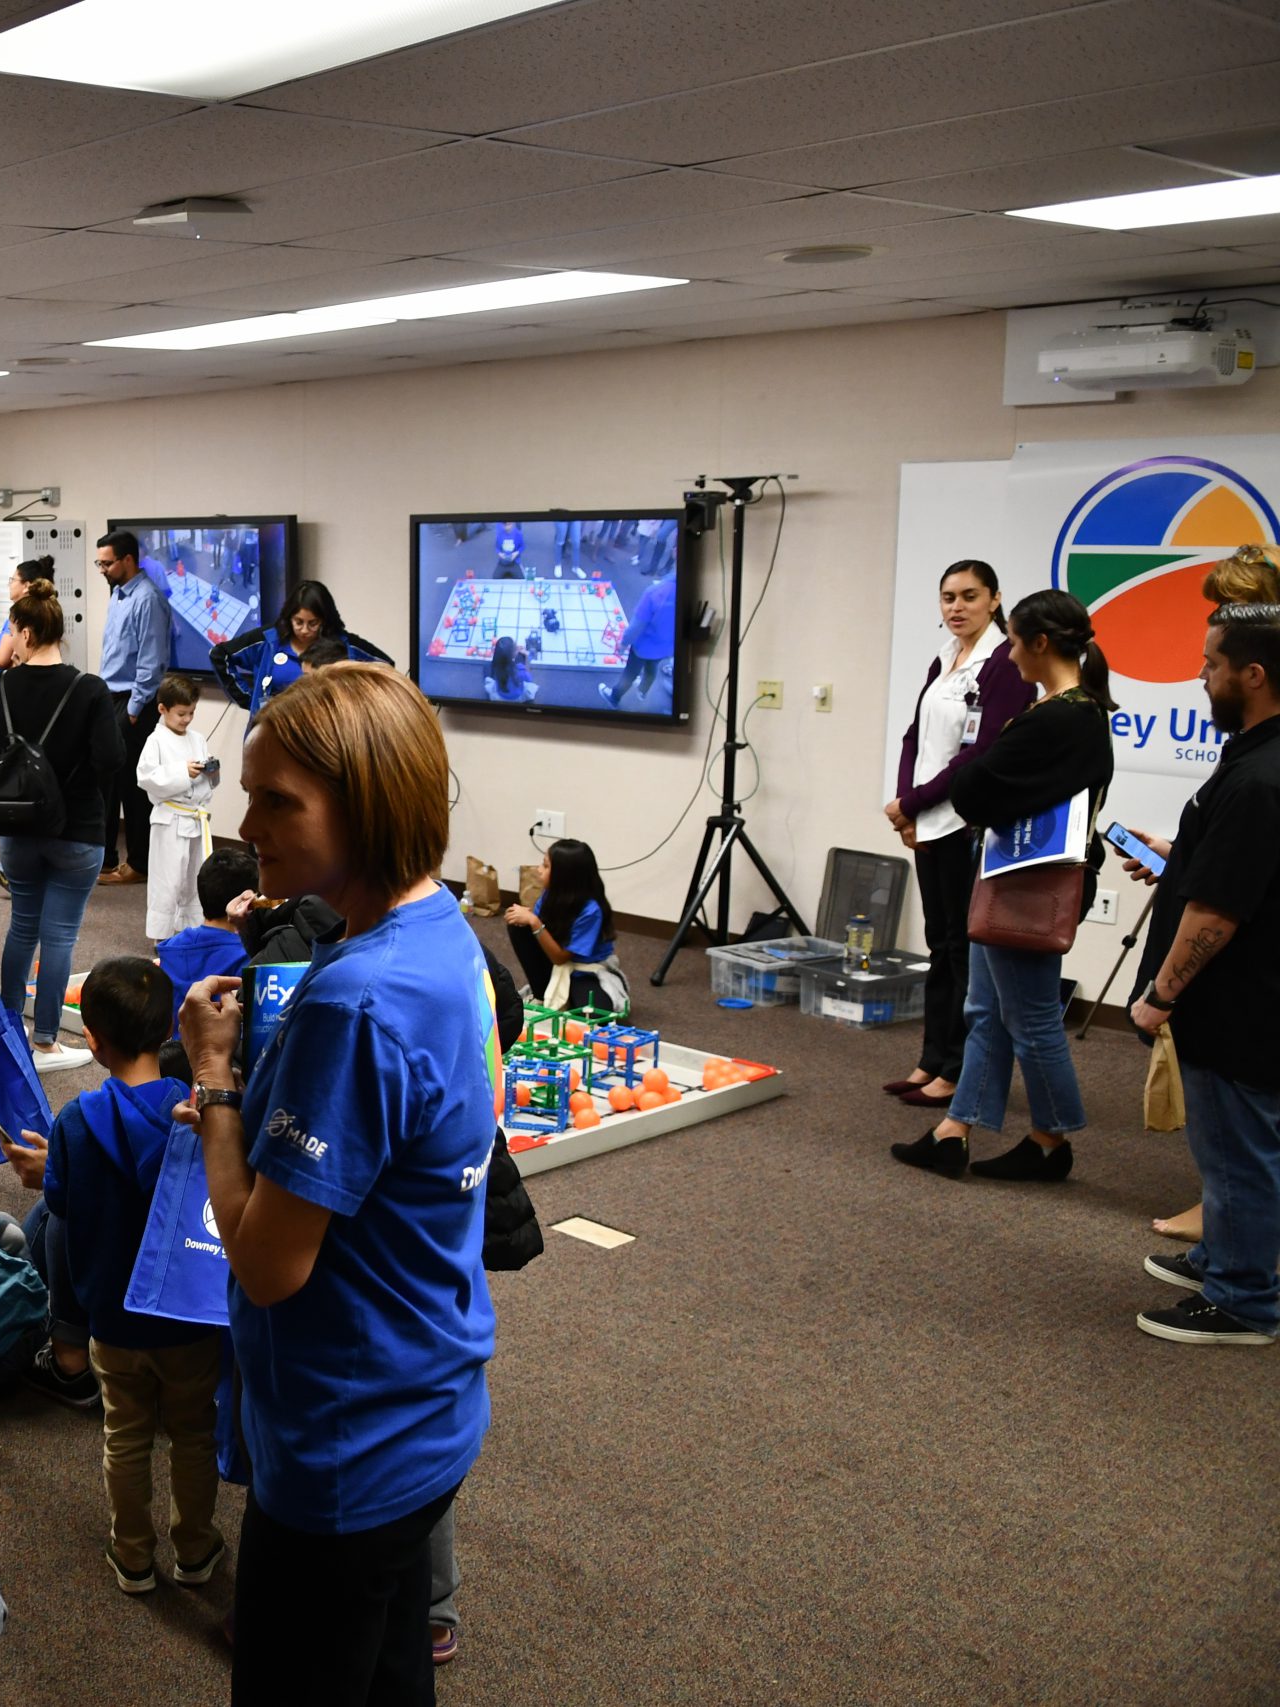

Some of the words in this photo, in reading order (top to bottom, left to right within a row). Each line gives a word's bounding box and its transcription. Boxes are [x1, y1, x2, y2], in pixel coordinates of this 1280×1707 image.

[1111, 712, 1157, 748] ey
[1170, 708, 1231, 745] Un
[1175, 748, 1218, 763] SCHO
[286, 1127, 329, 1157] MADE
[184, 1237, 221, 1256] Downey
